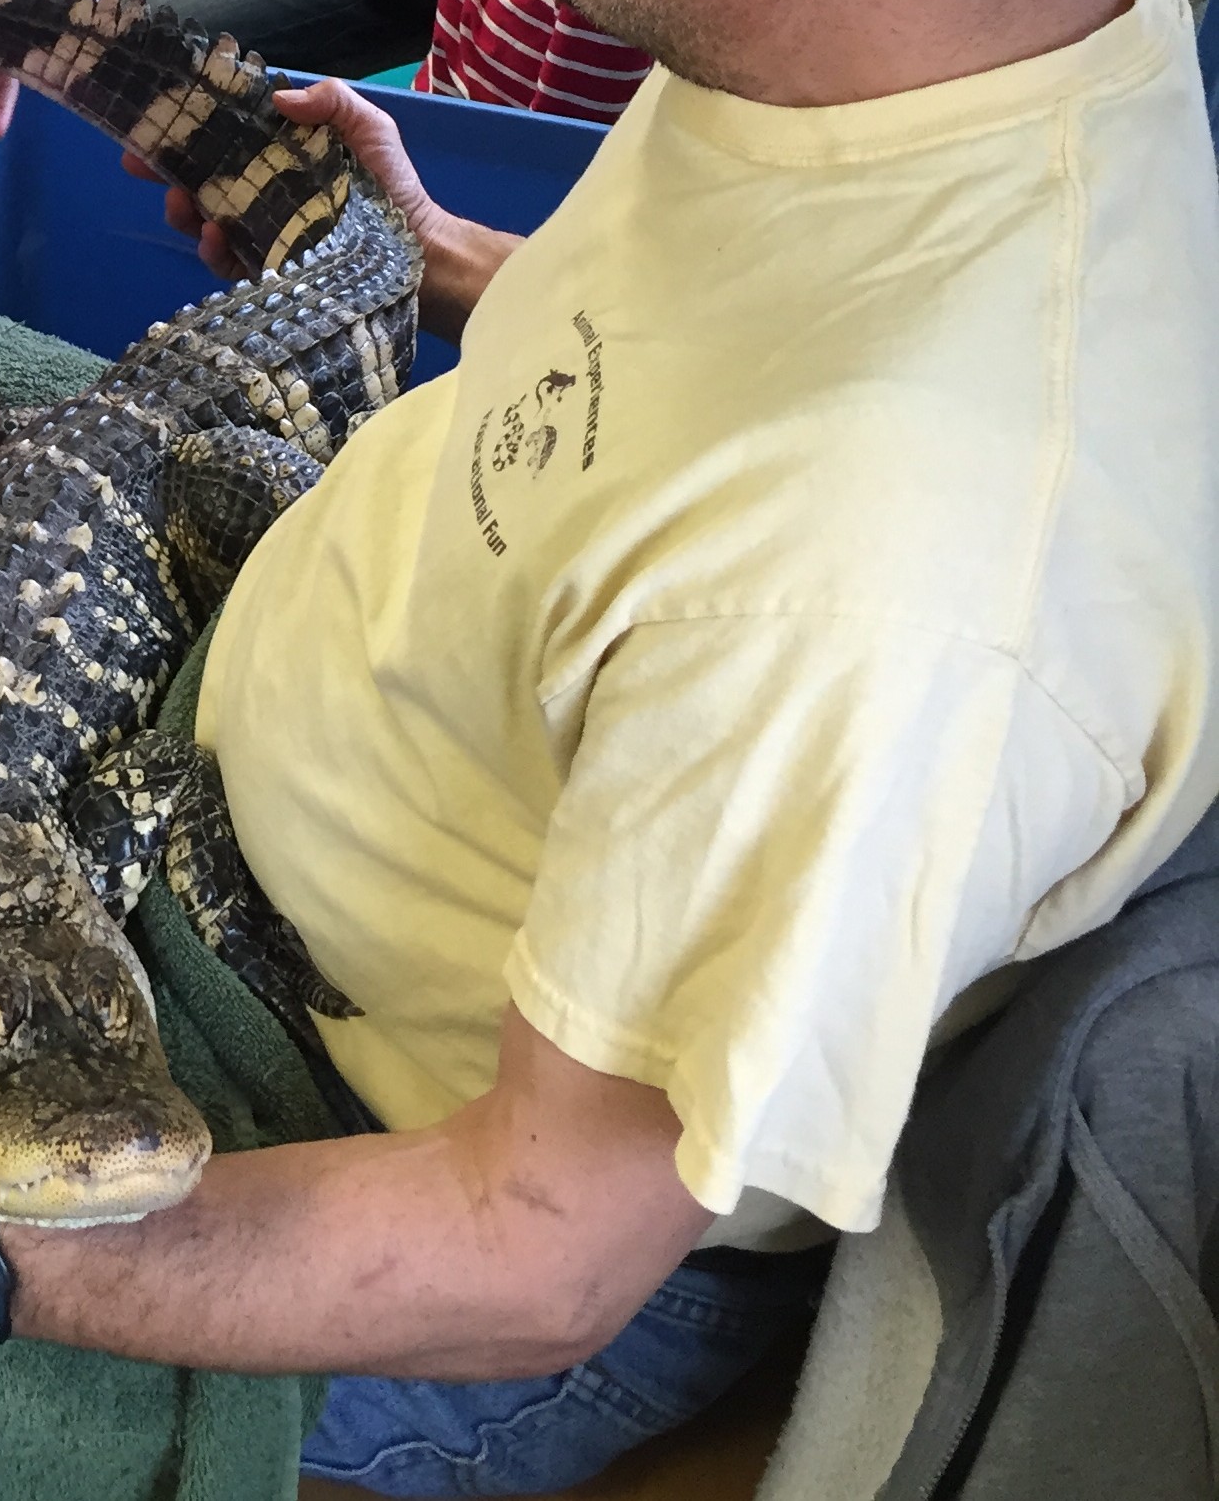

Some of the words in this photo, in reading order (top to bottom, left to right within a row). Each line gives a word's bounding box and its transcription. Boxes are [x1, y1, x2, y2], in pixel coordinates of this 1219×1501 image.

[571, 309, 599, 348] Animal
[582, 341, 605, 472] Experiences
[482, 519, 507, 558] Fun
